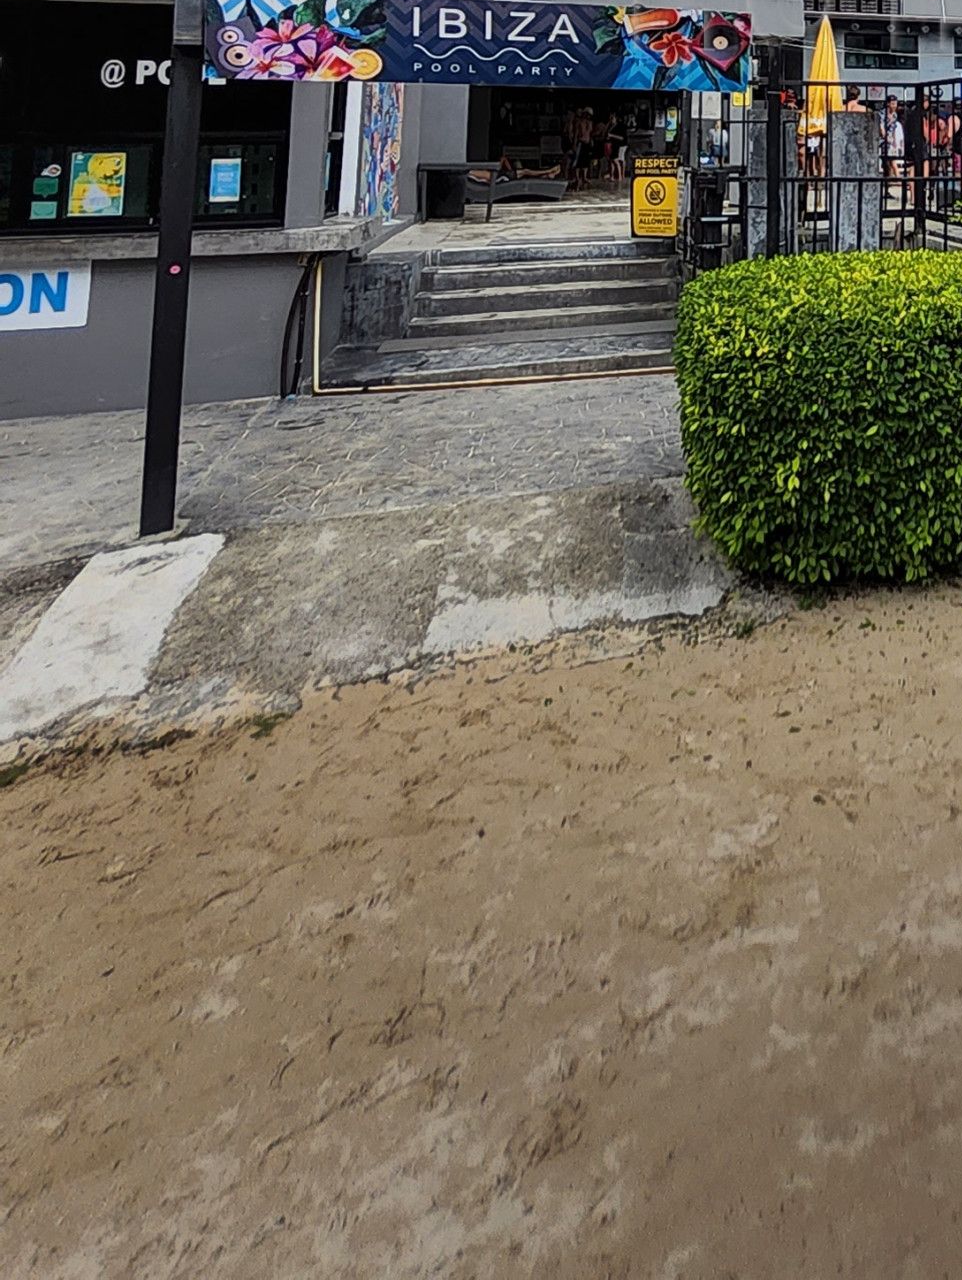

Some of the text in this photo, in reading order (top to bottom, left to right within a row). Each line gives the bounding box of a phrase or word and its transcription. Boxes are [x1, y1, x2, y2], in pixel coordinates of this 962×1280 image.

[412, 6, 580, 44] IBIZA
[100, 59, 227, 88] @ PO
[413, 62, 573, 77] POOL PARTY
[635, 158, 679, 168] RESPECT
